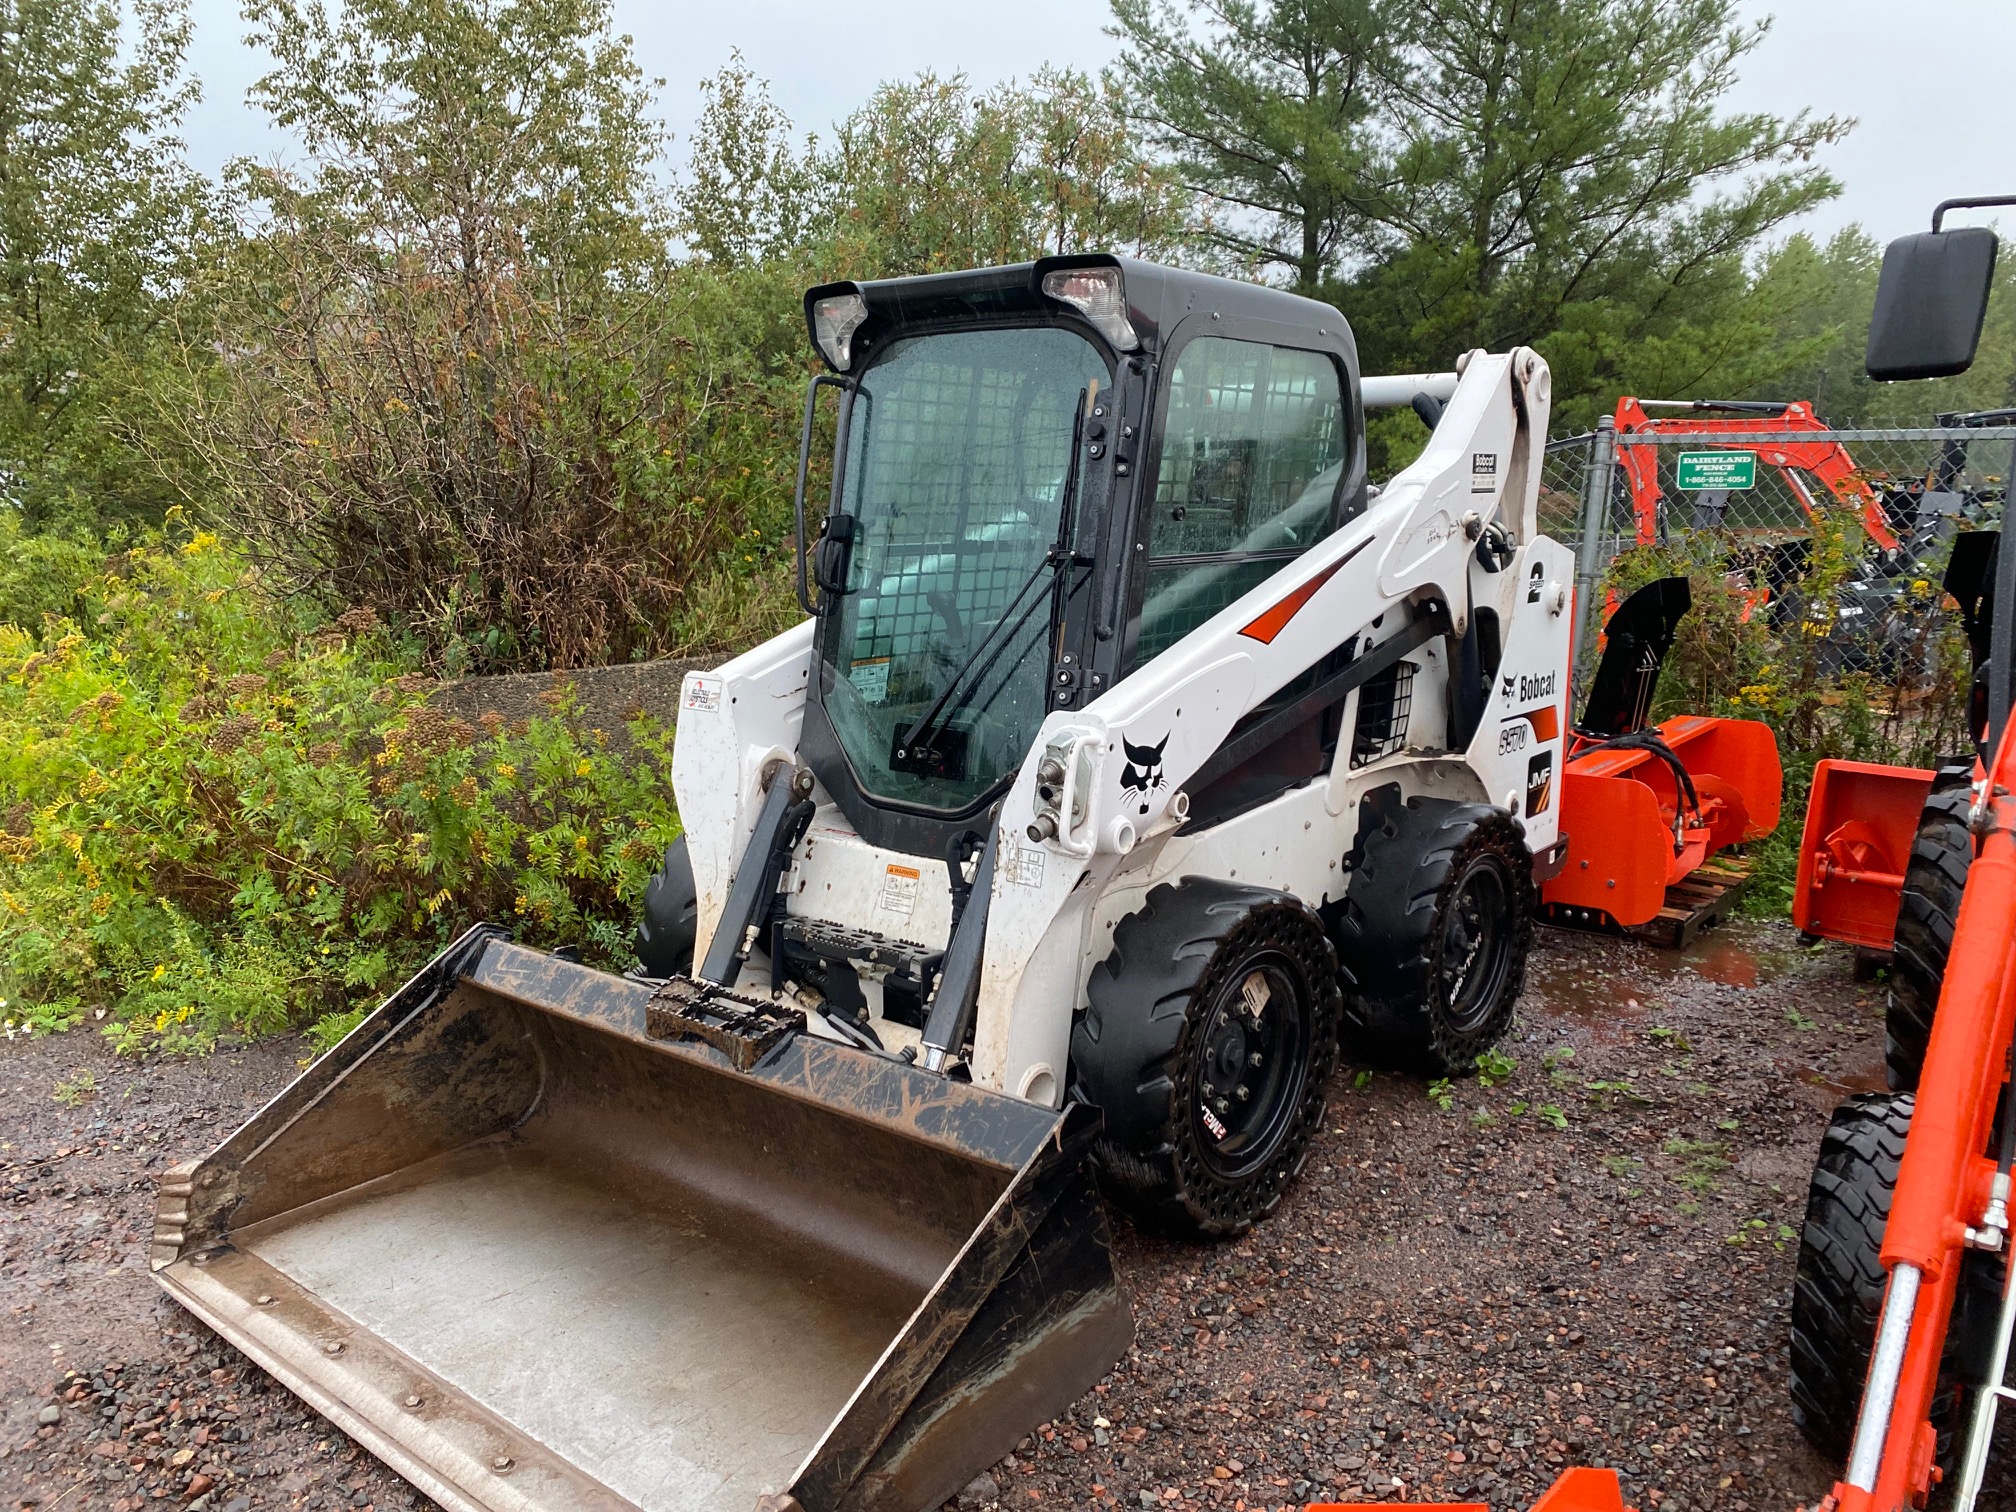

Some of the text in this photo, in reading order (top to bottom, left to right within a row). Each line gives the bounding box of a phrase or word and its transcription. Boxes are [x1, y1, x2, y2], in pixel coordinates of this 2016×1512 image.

[1683, 456, 1752, 464] DAIRYLAND
[1520, 670, 1556, 702] Bobcat
[1499, 724, 1528, 756] S570
[1528, 767, 1551, 789] JMF
